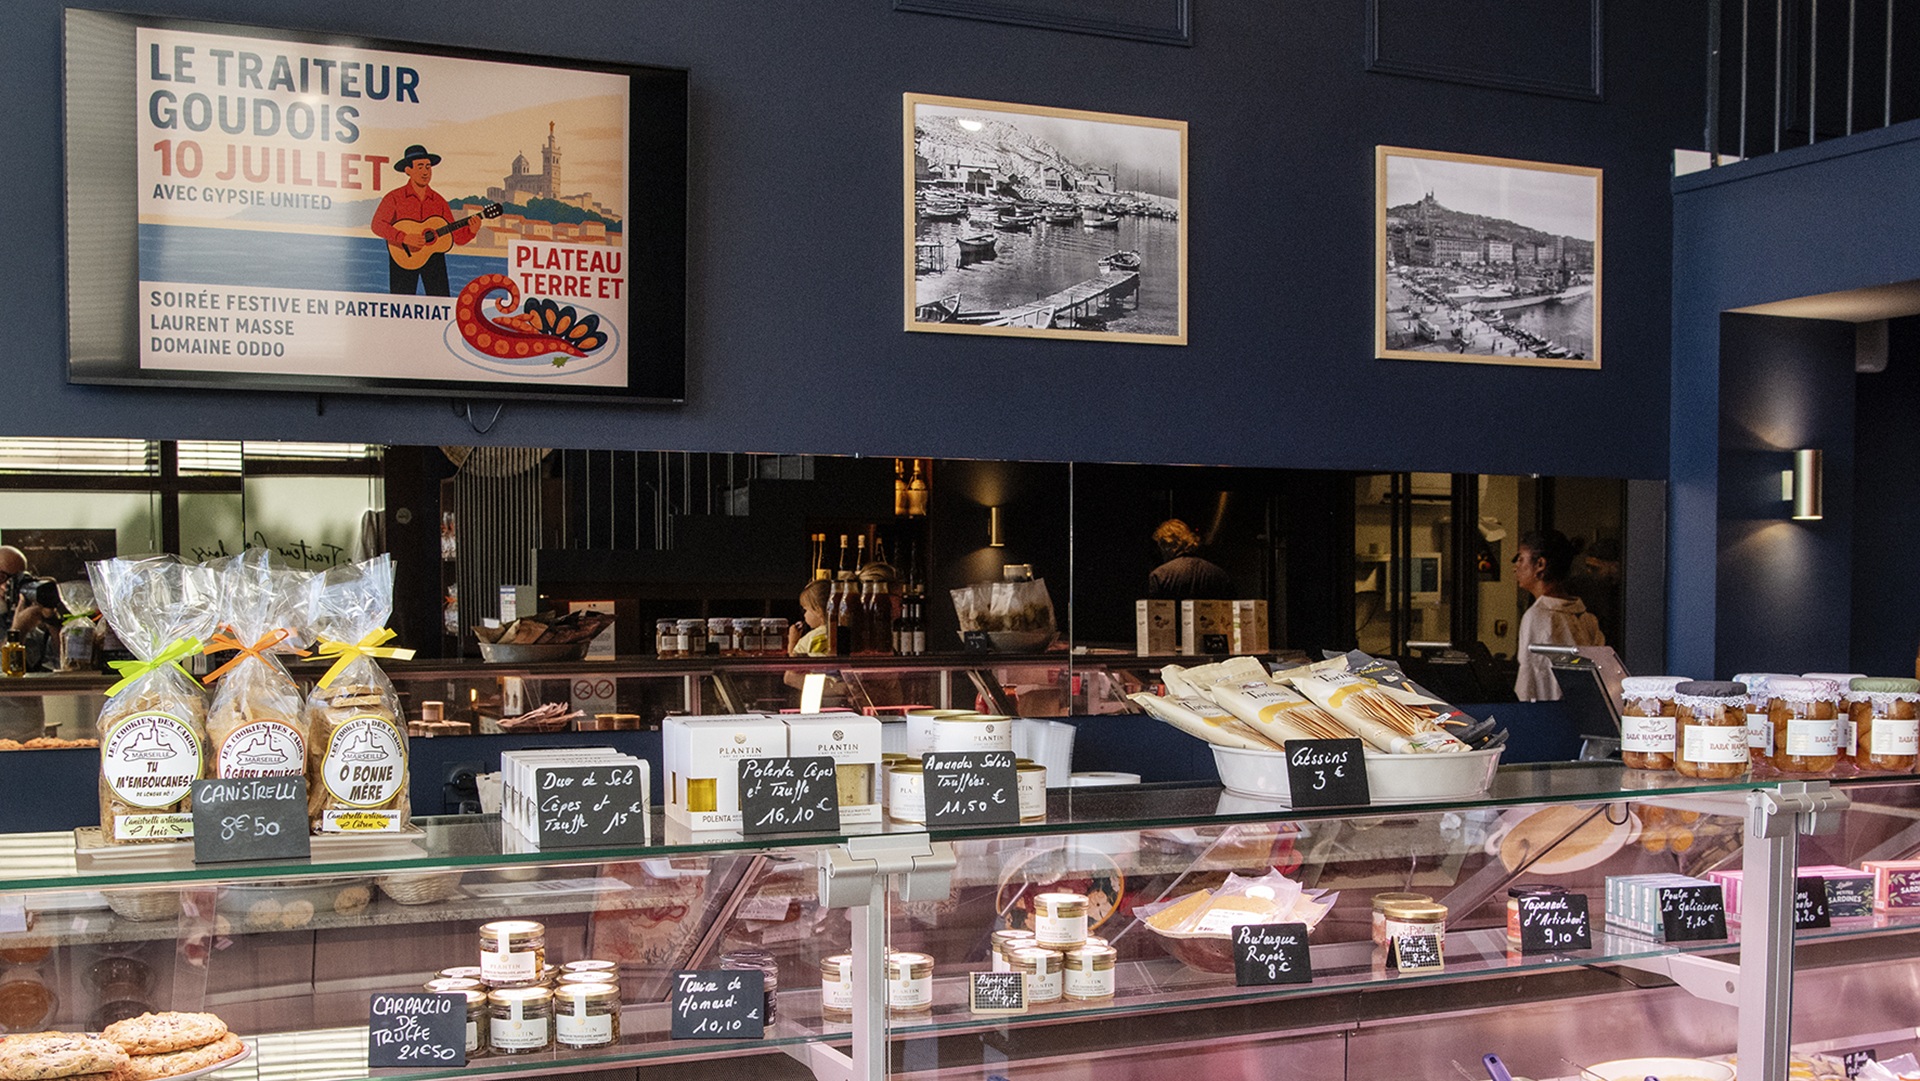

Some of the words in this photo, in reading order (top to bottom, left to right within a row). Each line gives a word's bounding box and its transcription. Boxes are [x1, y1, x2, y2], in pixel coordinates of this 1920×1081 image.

[150, 43, 196, 84] LE
[210, 48, 420, 104] TRAITEUR
[149, 90, 360, 144] GOUDOIS
[154, 139, 203, 179] 10
[215, 144, 389, 192] JUILLET
[153, 184, 198, 202] AVEC
[203, 187, 266, 206] GYPSIE
[270, 192, 331, 210] UNITED
[516, 245, 622, 274] PLATEAU
[520, 273, 591, 298] TERRE
[598, 278, 624, 300] ET
[151, 288, 221, 311] SOIRÉE
[226, 295, 301, 314] FESTIVE
[307, 298, 329, 315] EN
[335, 300, 451, 321] PARTENARIAT
[151, 315, 229, 334] LAURENT
[236, 318, 294, 336] MASSE
[151, 338, 232, 356] DOMAINE
[237, 340, 284, 357] ODDO
[108, 740, 117, 758] LES
[116, 717, 153, 739] COOKIES
[158, 718, 175, 728] DES
[222, 744, 232, 760] LES
[232, 724, 267, 742] COOKIES
[272, 724, 288, 733] DES
[330, 743, 339, 758] LES
[336, 720, 367, 740] COOKIES
[371, 720, 386, 730] DES
[719, 747, 762, 755] PLANTIN
[147, 762, 158, 772] TU
[742, 759, 794, 779] Polenta
[803, 762, 834, 781] Cèpes
[925, 754, 973, 771] Amandes
[116, 775, 193, 789] M'EMBOUCANES!
[353, 765, 393, 782] BONNE
[542, 772, 575, 790] Duo
[582, 772, 597, 787] de
[605, 769, 633, 786] Sels
[746, 780, 762, 798] et
[770, 779, 810, 804] Truffe
[327, 811, 362, 820] Canistrelli
[541, 795, 582, 818] Cèpes
[593, 794, 610, 811] et
[124, 816, 159, 827] Canistrelli
[352, 819, 373, 829] Citron
[545, 813, 588, 834] Truffe
[702, 815, 732, 823] POLENTA
[145, 825, 169, 837] Anis
[1520, 897, 1568, 916] Tapenade
[1828, 896, 1862, 904] SARDINES
[1237, 926, 1298, 951] Poutargue
[727, 976, 741, 991] de
[394, 1015, 418, 1031] DE
[372, 1026, 430, 1047] TRUFFE
